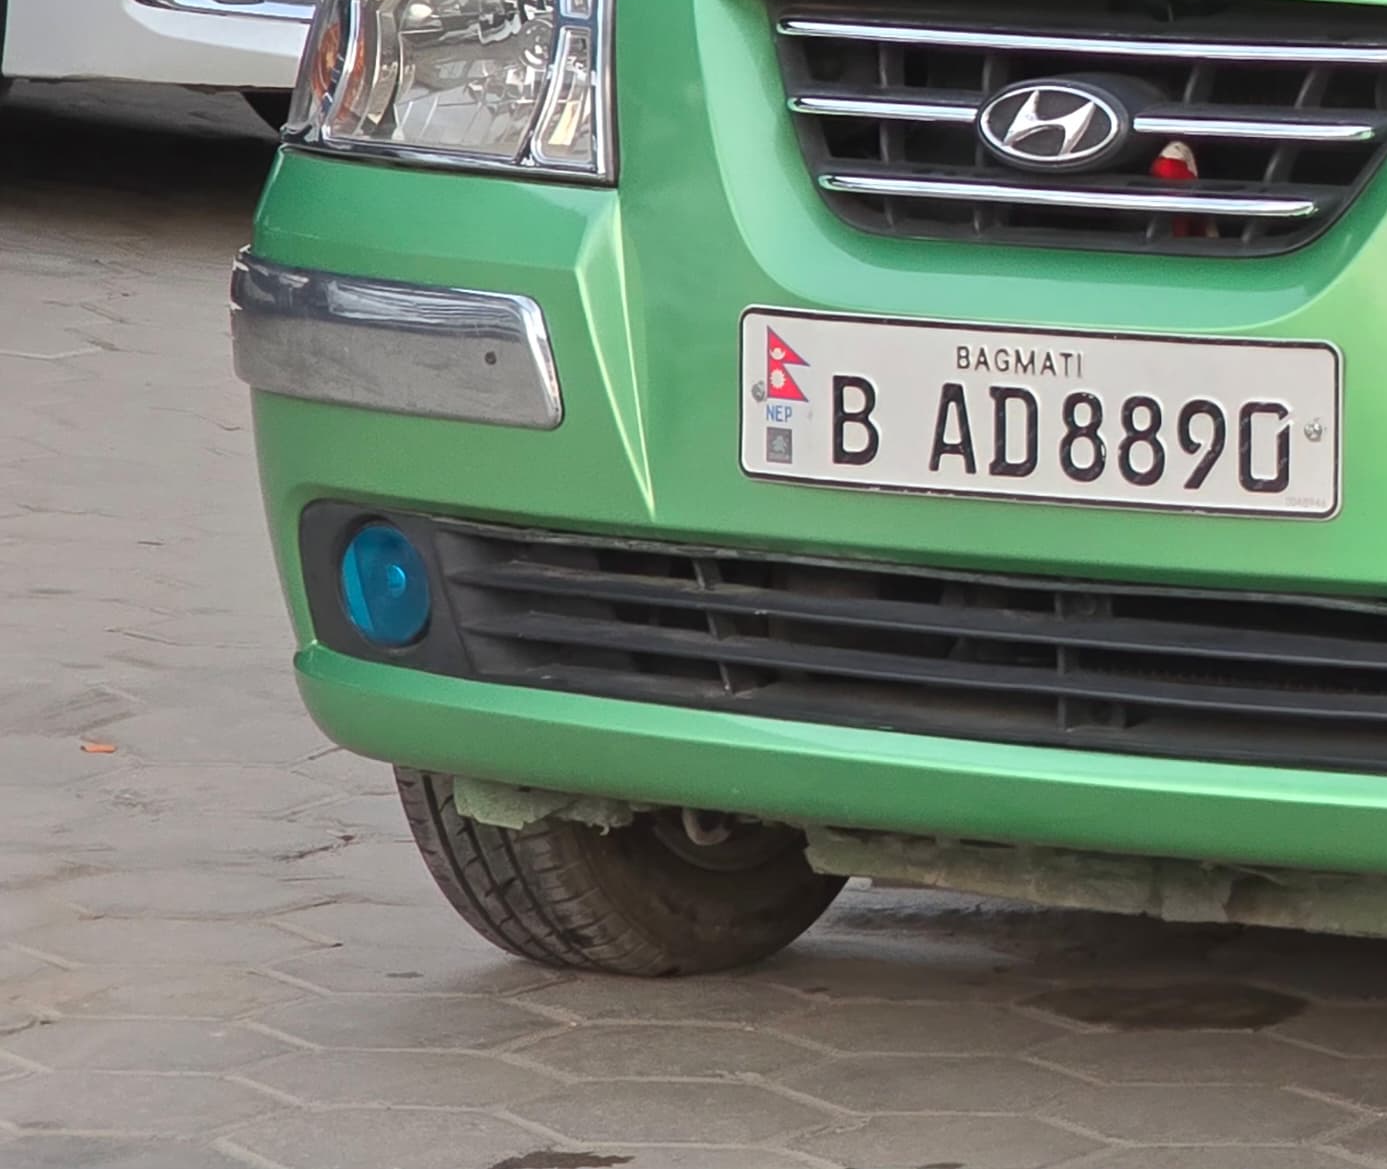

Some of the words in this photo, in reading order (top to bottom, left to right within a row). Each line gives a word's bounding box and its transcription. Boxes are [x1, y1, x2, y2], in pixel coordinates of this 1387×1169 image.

[956, 345, 1083, 378] BAGMATI
[766, 404, 793, 422] NEP
[832, 375, 880, 465] B
